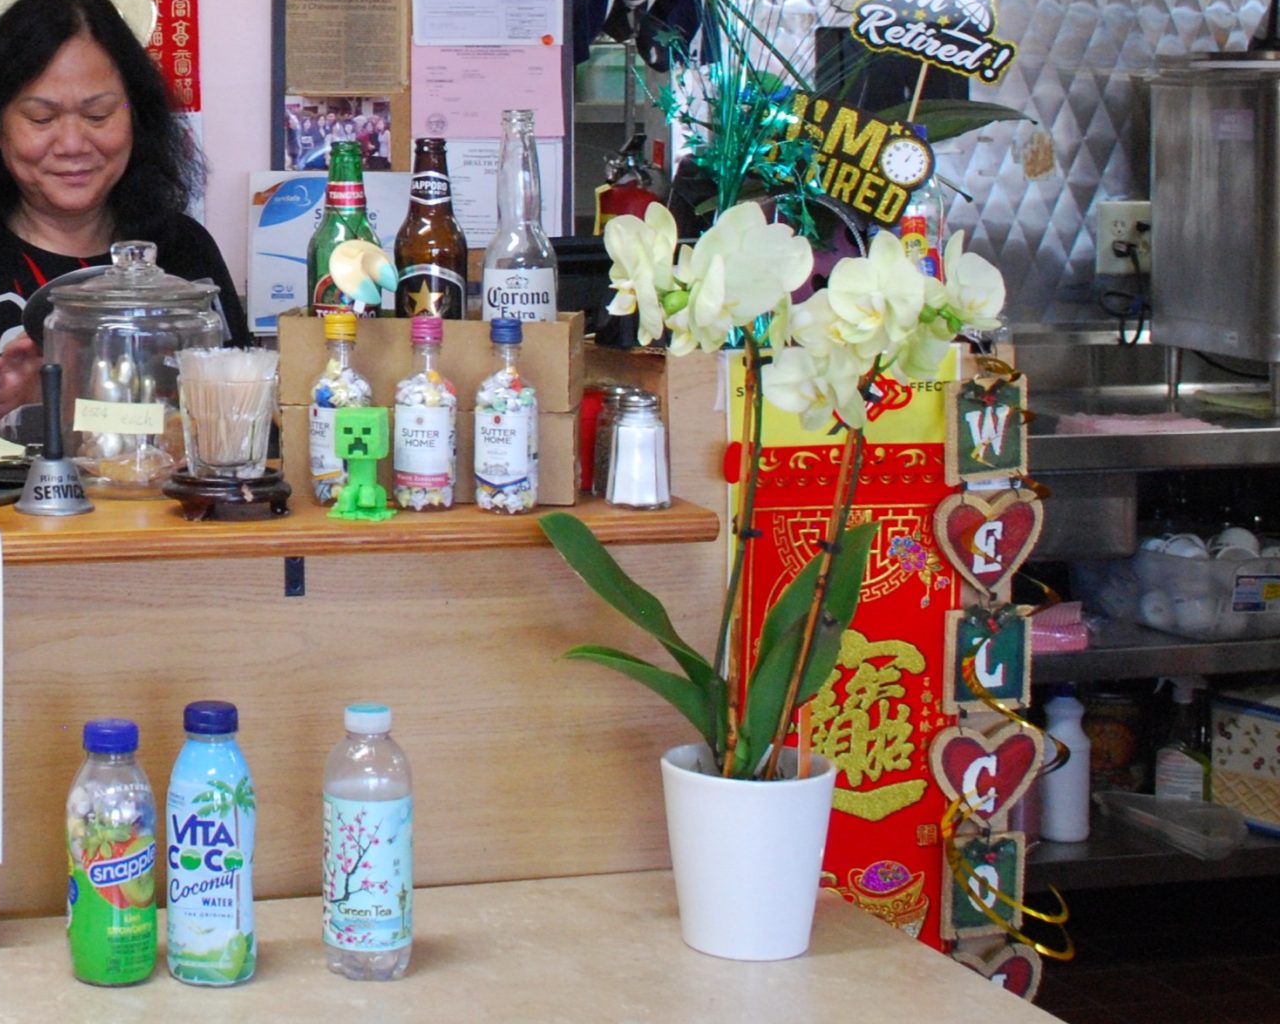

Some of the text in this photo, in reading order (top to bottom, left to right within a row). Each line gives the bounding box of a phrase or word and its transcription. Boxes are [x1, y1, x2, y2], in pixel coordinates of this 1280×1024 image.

[856, 4, 1010, 78] Retired!
[786, 93, 888, 171] I'M
[487, 287, 550, 308] Corona
[499, 307, 536, 320] Extra
[401, 428, 440, 439] SUTTER
[480, 426, 517, 437] SUTTER
[405, 439, 436, 448] HOME
[484, 436, 512, 445] HOME
[33, 484, 86, 501] SERVIC
[172, 814, 235, 847] VITA
[168, 844, 244, 871] COCO
[170, 867, 238, 903] Coconut
[202, 897, 233, 907] WATER
[337, 902, 393, 917] Green Tea
